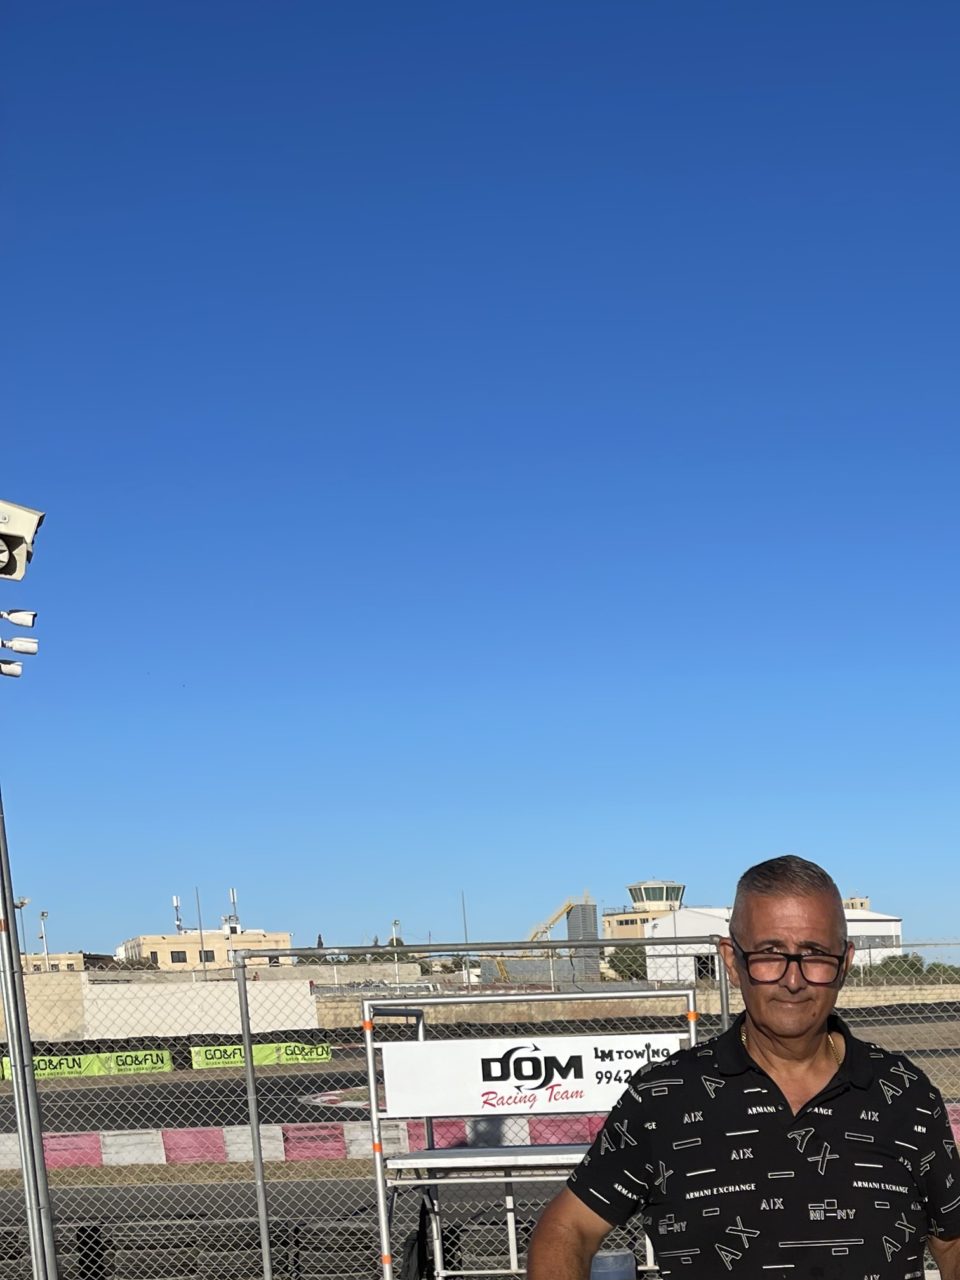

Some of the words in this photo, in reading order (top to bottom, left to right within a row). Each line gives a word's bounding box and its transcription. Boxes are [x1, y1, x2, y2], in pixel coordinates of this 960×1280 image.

[205, 1048, 245, 1060] GO&FU
[285, 1045, 329, 1057] GO&FUN
[116, 1053, 164, 1067] GO&FUN
[481, 1049, 584, 1086] DOM
[481, 1091, 538, 1109] Racing
[545, 1083, 585, 1103] Team
[747, 1106, 776, 1115] ARMANI
[685, 1188, 712, 1199] ARMANI
[713, 1183, 757, 1195] EXCHANGE
[852, 1180, 880, 1190] ARMANI
[881, 1183, 909, 1194] EXCHANGE
